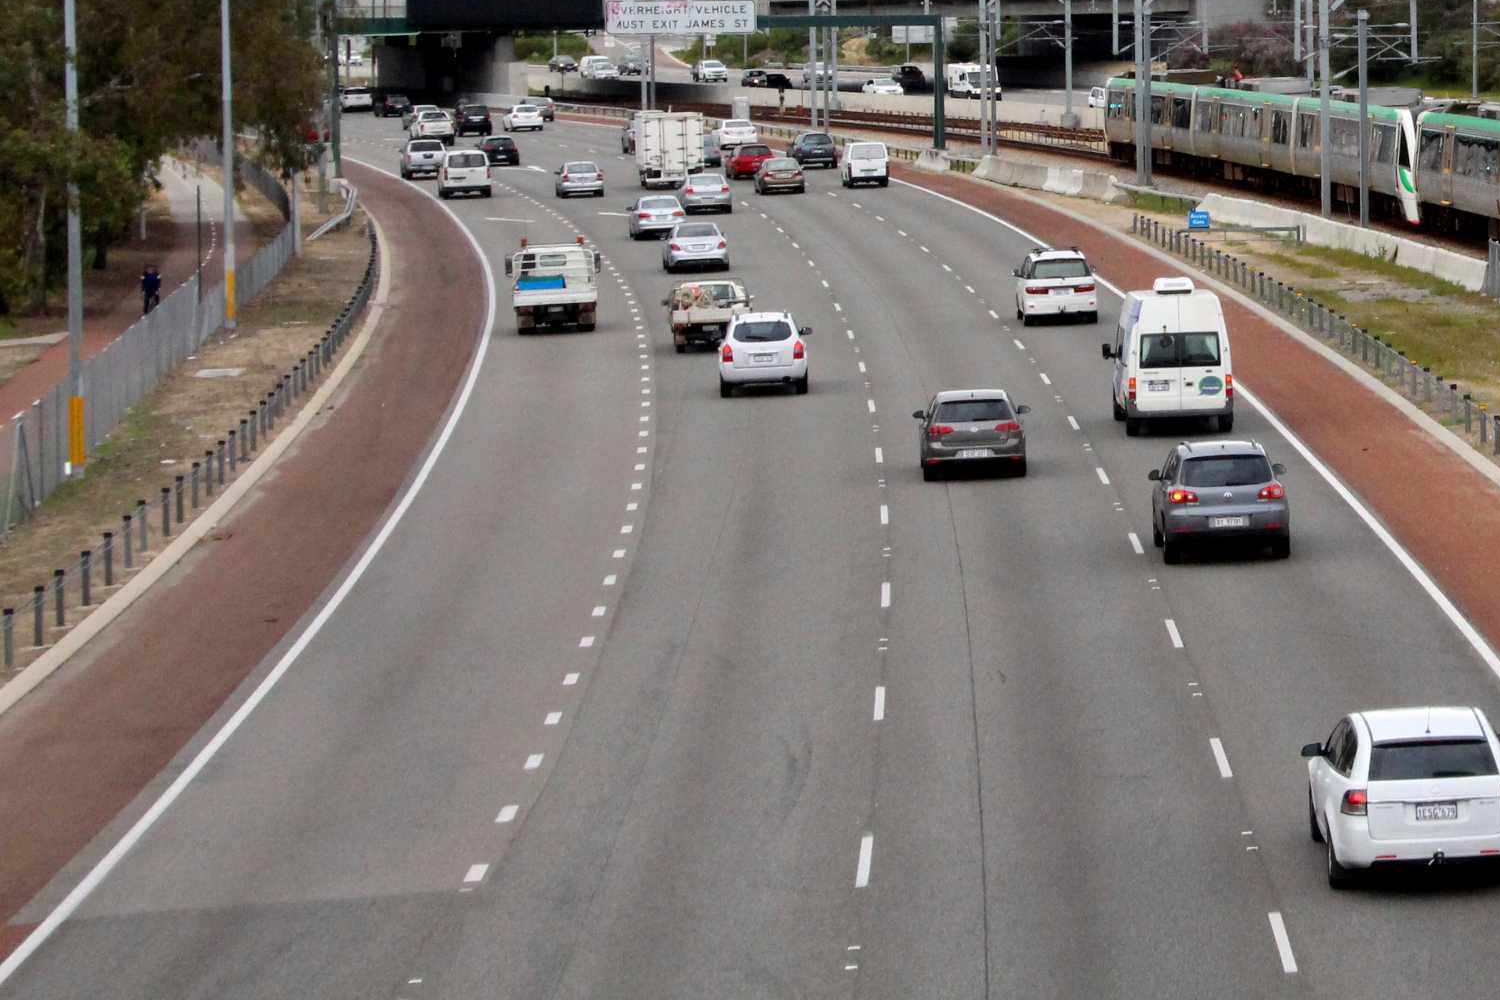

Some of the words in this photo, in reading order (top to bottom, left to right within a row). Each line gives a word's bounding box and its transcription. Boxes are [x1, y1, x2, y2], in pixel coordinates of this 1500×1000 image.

[611, 5, 688, 15] OVERHEGHT
[696, 4, 747, 14] VEHICLE
[652, 19, 678, 29] EXIT
[686, 19, 725, 29] JAMES
[735, 18, 748, 28] ST
